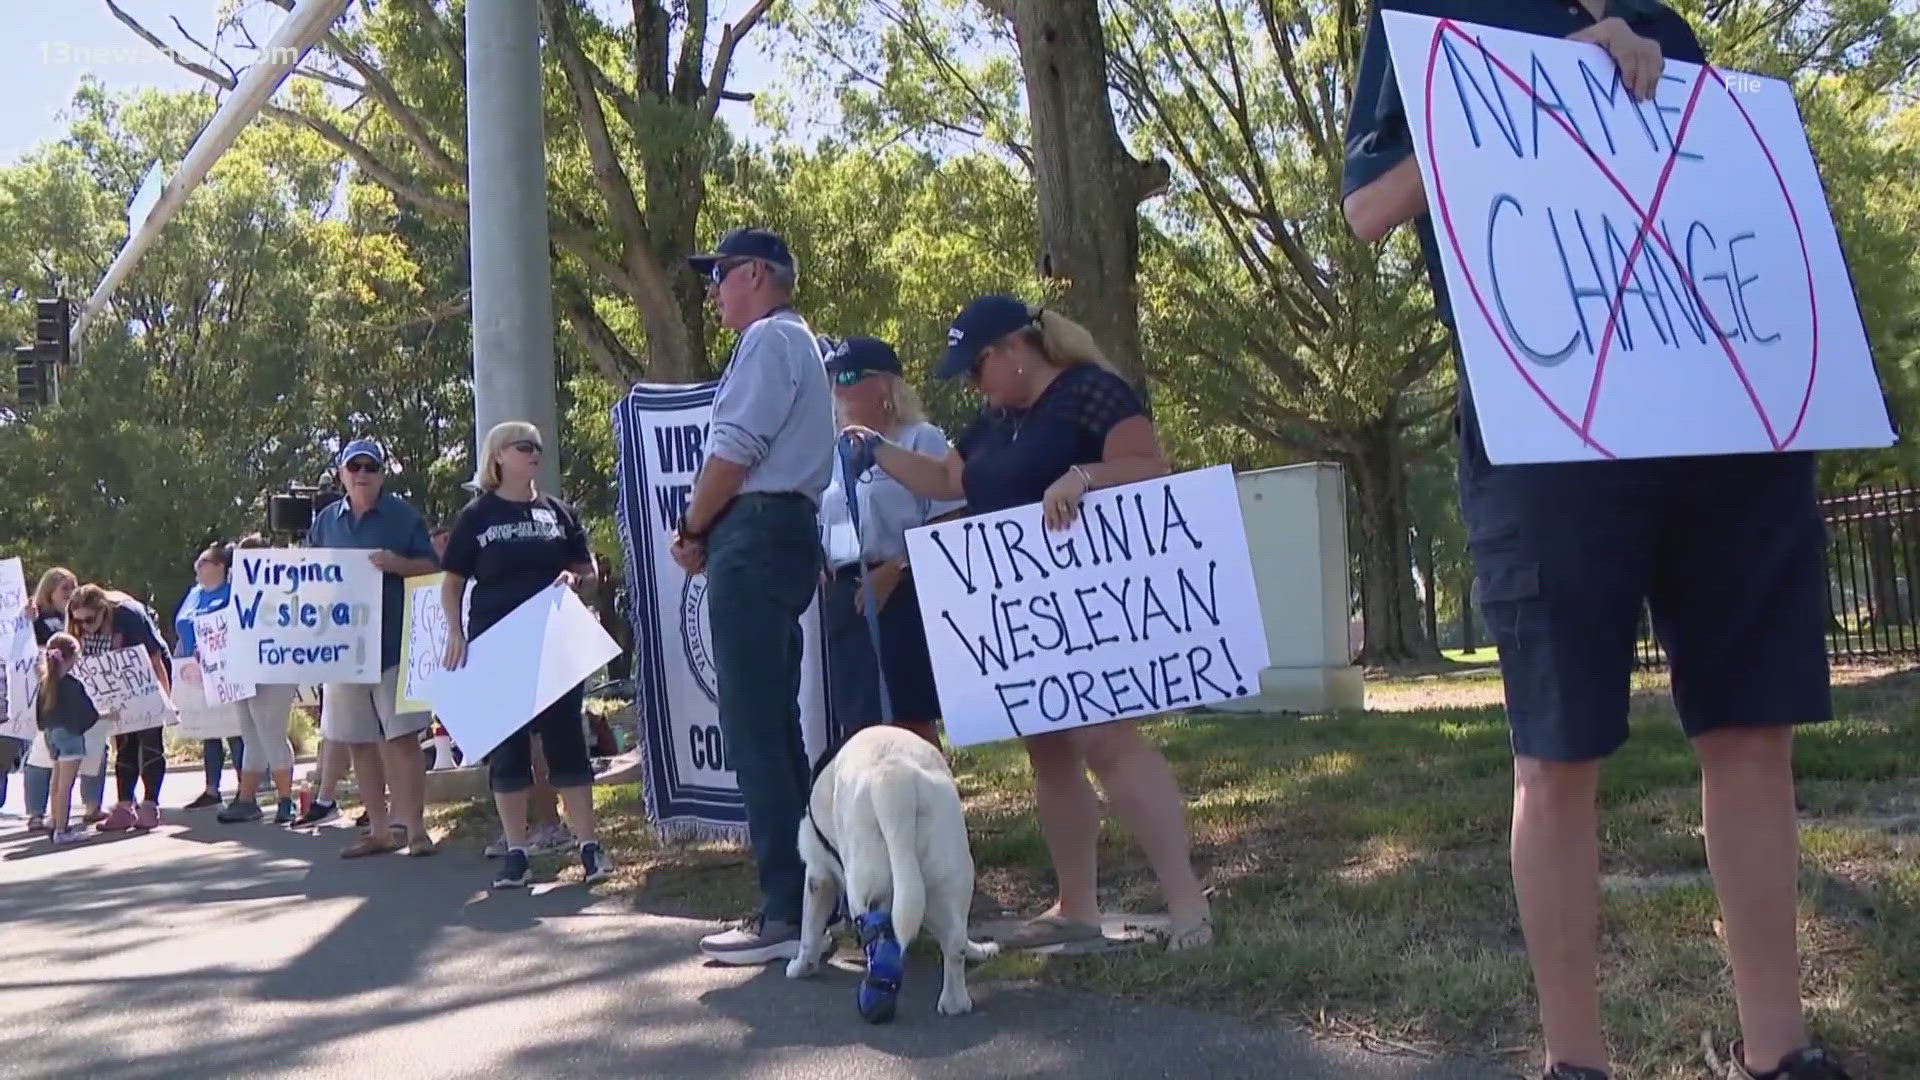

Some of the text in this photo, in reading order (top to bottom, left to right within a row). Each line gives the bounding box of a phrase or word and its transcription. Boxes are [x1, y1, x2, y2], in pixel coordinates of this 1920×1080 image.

[1441, 34, 1704, 160] NAME
[1486, 192, 1782, 367] CHANGE
[242, 557, 344, 595] Virgina
[931, 484, 1203, 594] VIRGINIA
[234, 590, 371, 636] Wesleyan
[687, 582, 708, 675] VIRGINIA
[941, 560, 1221, 676] WESLEYAN
[994, 637, 1249, 737] FOREVER!
